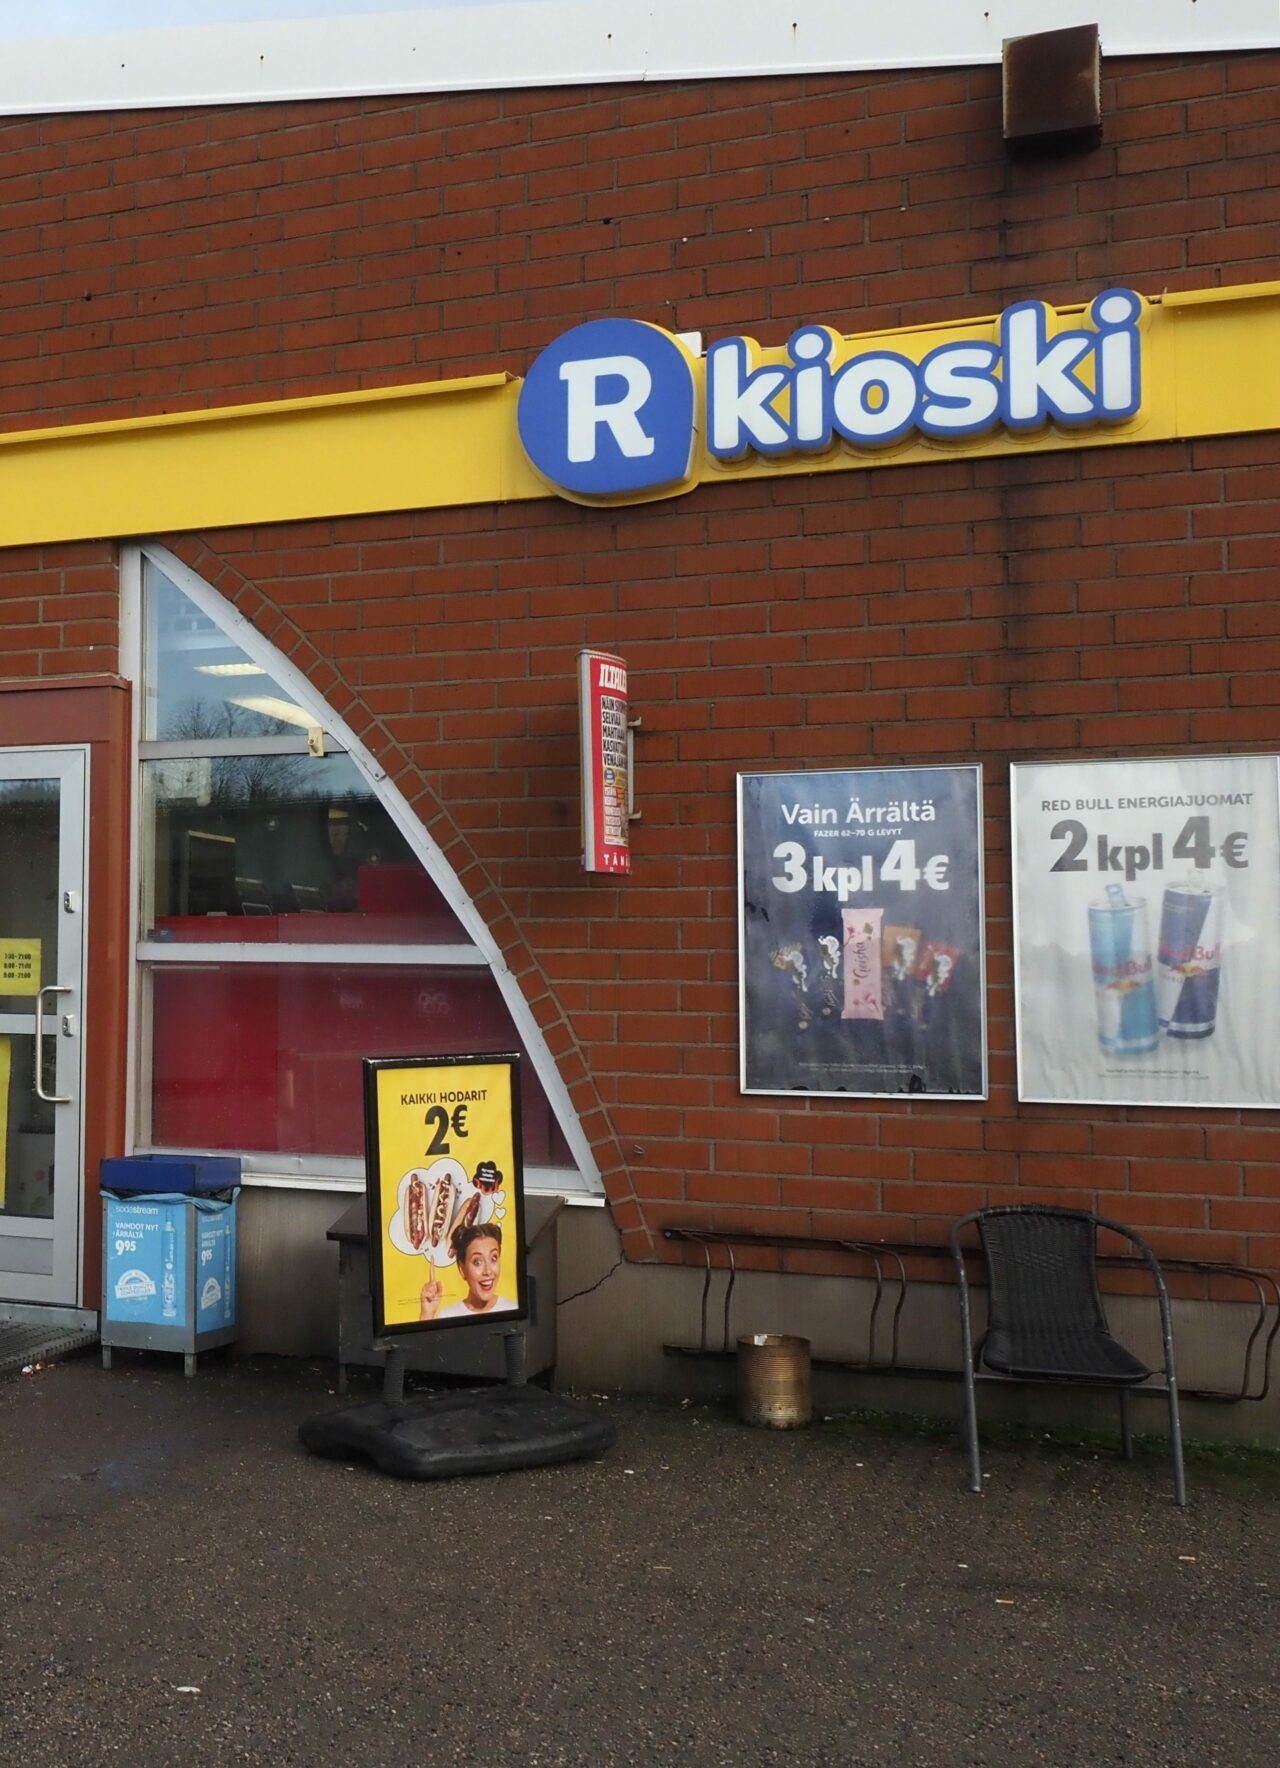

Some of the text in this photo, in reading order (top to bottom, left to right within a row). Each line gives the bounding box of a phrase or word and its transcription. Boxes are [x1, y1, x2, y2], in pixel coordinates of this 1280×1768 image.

[712, 294, 1141, 451] kioski
[781, 797, 936, 824] Vain Ärrältä
[1041, 793, 1253, 811] RED BULL ENERGIAJUOMAT
[867, 828, 875, 836] G
[876, 828, 902, 836] LEVYT
[1049, 819, 1088, 873] 2
[1098, 832, 1164, 881] kpl
[772, 841, 807, 893] 3
[813, 855, 873, 901] kpl
[852, 941, 868, 978] Geisha
[400, 1090, 487, 1105] KAIKKI HODARIT
[424, 1104, 469, 1156] 2€
[115, 1205, 159, 1215] sodastream
